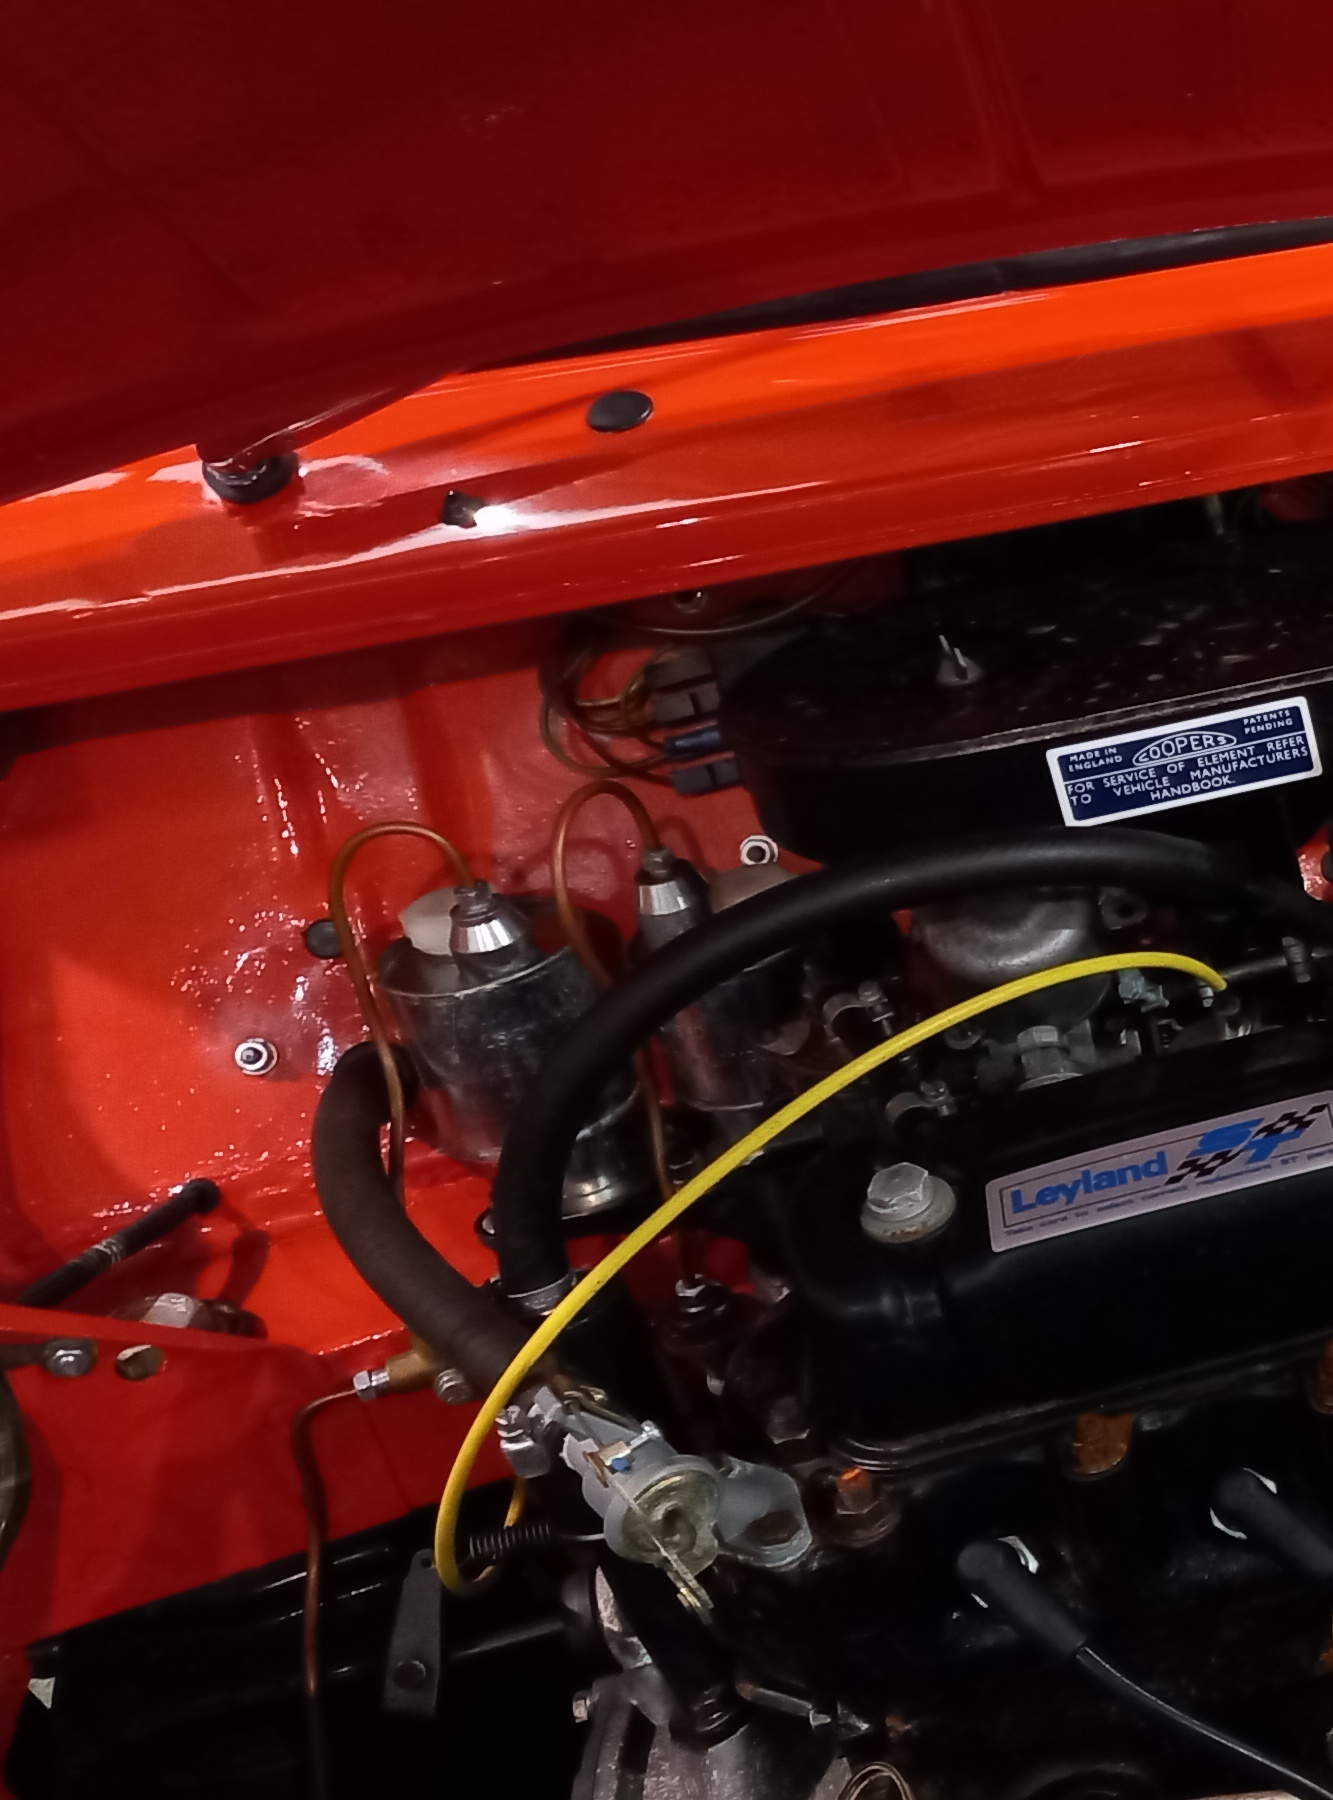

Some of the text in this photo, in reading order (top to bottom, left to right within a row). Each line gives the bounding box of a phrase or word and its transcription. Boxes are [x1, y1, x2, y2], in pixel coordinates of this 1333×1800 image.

[1243, 709, 1290, 726] PATENTS
[1244, 718, 1293, 735] PENDING
[1069, 747, 1118, 762] MADE IN
[1067, 735, 1305, 795] FOR SERVICE OF ELEMENT REFER
[1068, 755, 1123, 773] ENGLAND
[1070, 746, 1308, 806] TO VEHICLE MANUFACTURERS
[1011, 1150, 1169, 1214] Leyland
